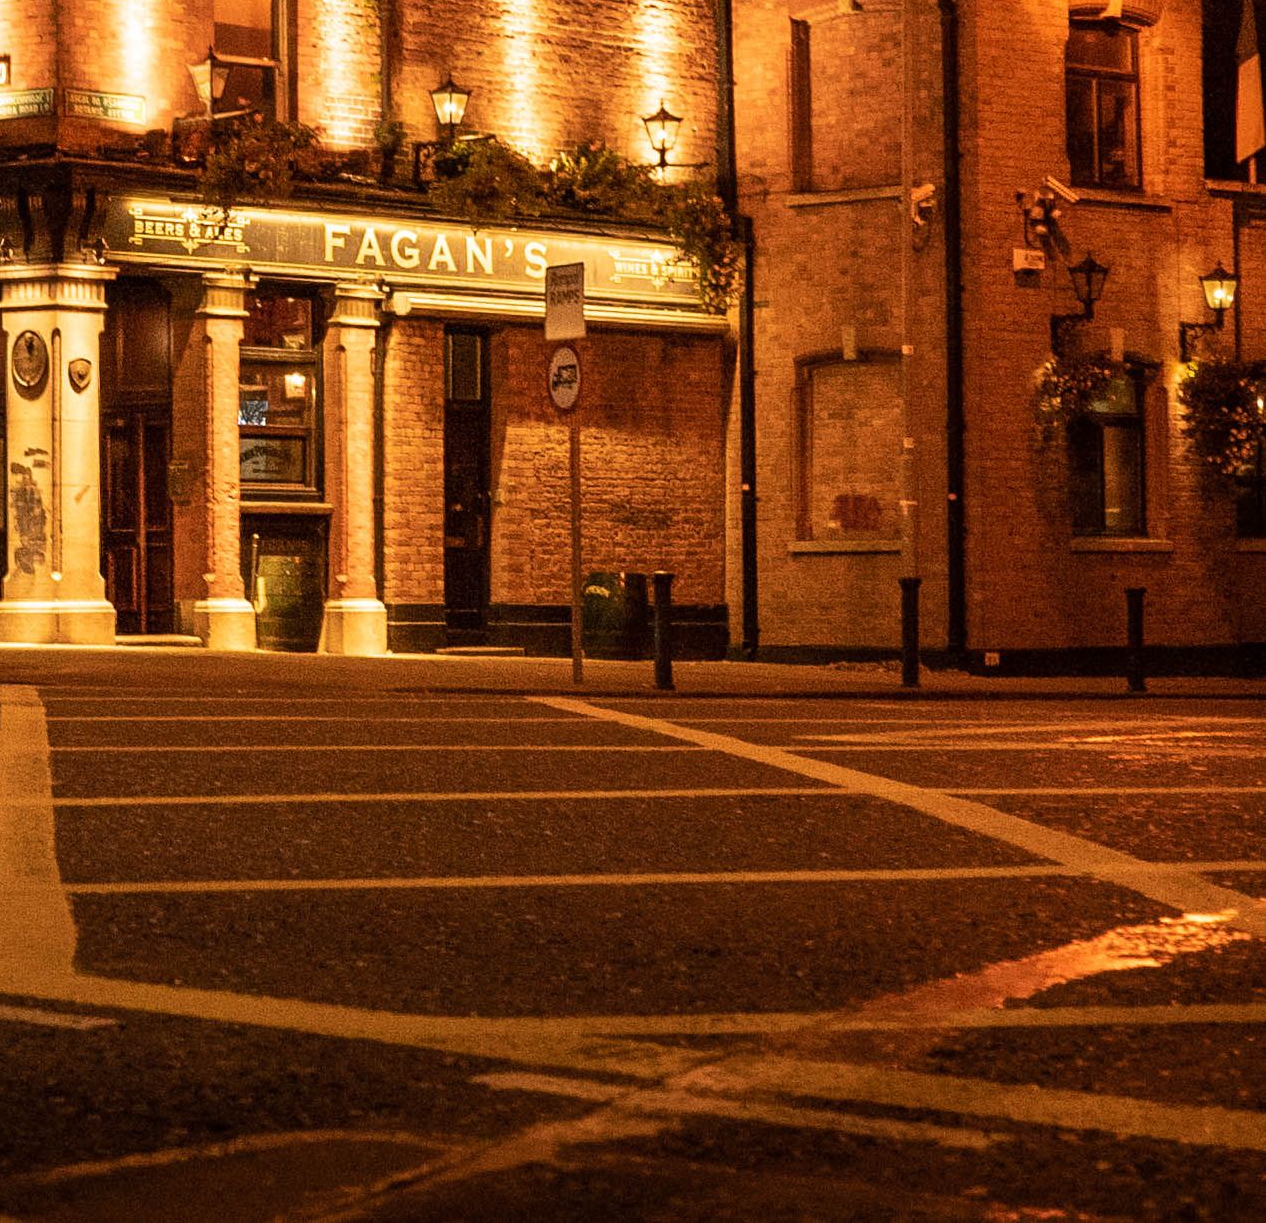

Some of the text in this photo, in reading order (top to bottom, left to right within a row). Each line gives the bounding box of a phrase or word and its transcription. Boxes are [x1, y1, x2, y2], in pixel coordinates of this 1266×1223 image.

[134, 220, 184, 237] BEERS
[189, 223, 201, 238] &
[324, 223, 549, 279] FAGAN'S
